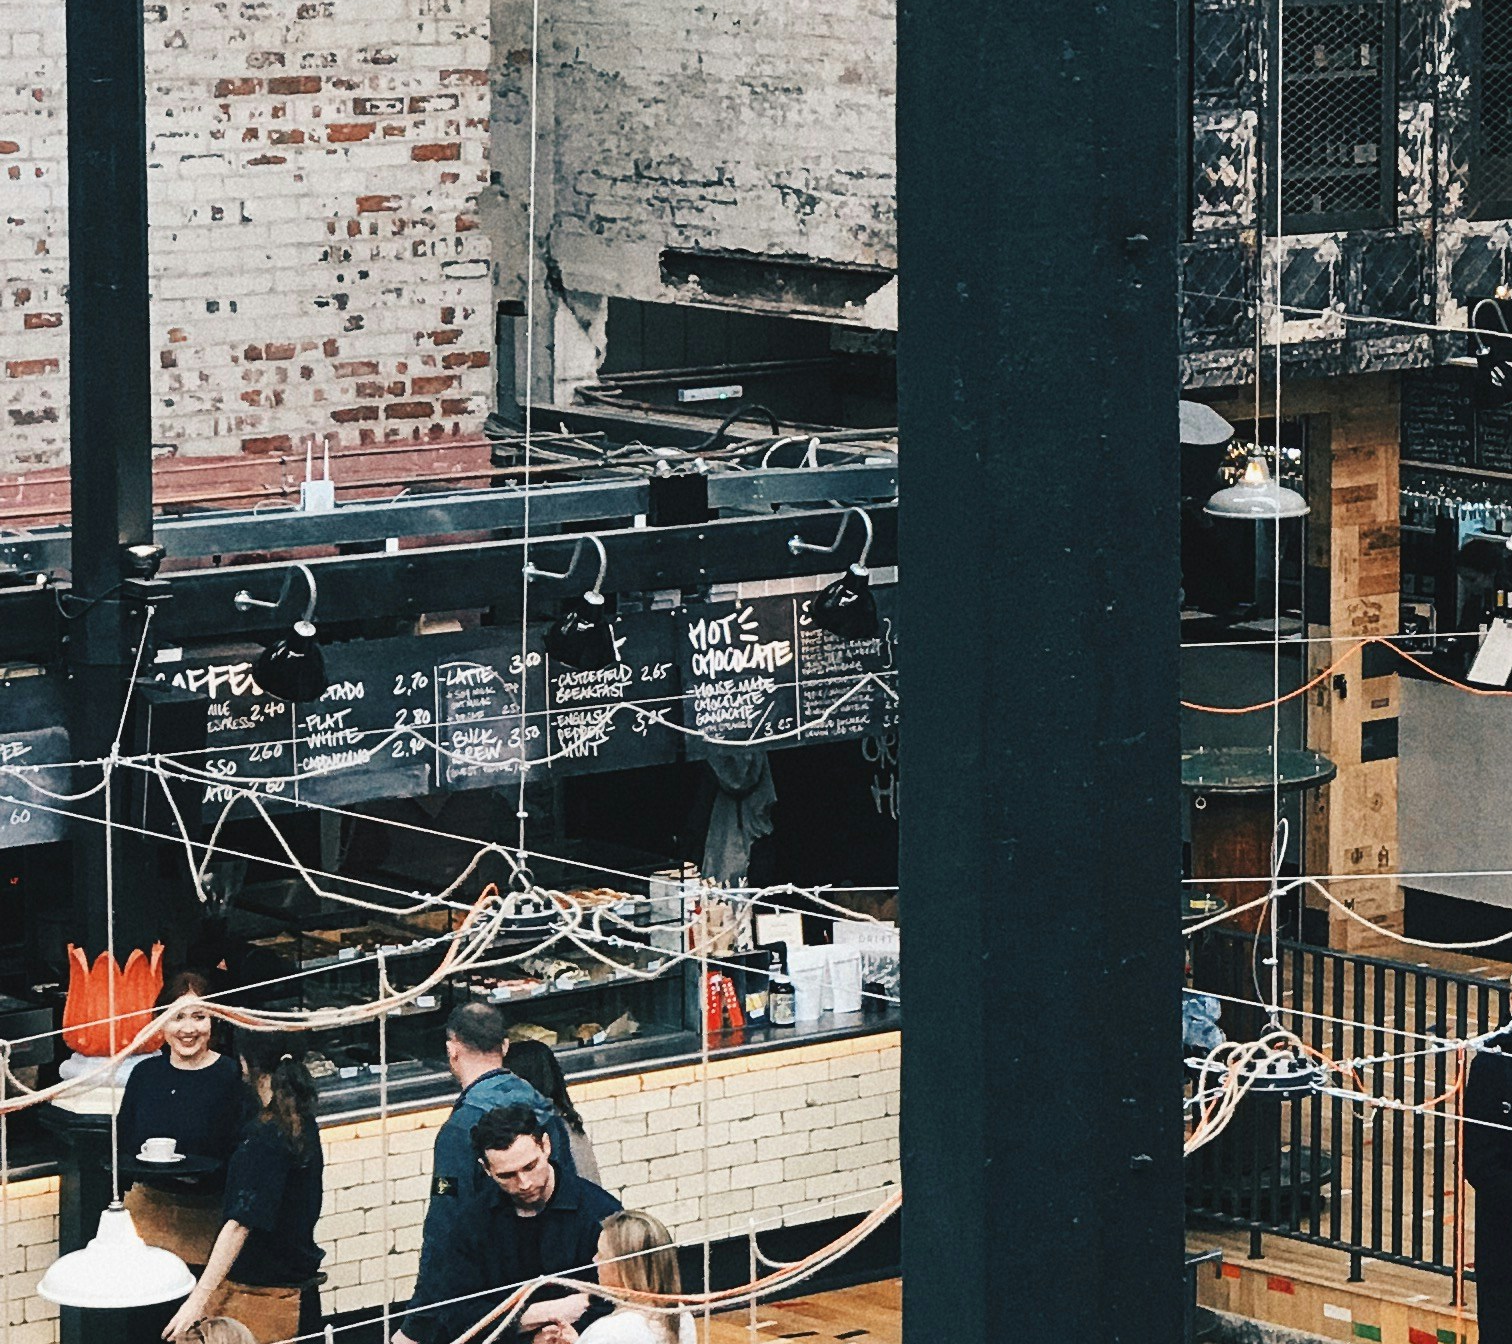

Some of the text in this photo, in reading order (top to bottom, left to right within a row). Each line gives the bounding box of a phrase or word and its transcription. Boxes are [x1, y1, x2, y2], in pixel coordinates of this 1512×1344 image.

[688, 613, 738, 651] HOT
[692, 640, 794, 680] CHOCOLATE
[446, 665, 496, 687] LATTE
[558, 663, 633, 688] CASTLEFIELD
[556, 681, 633, 704] BREAKFAST
[694, 691, 766, 712] CHOCOLATE
[305, 708, 352, 731] FLAT
[307, 727, 366, 750] WHITE
